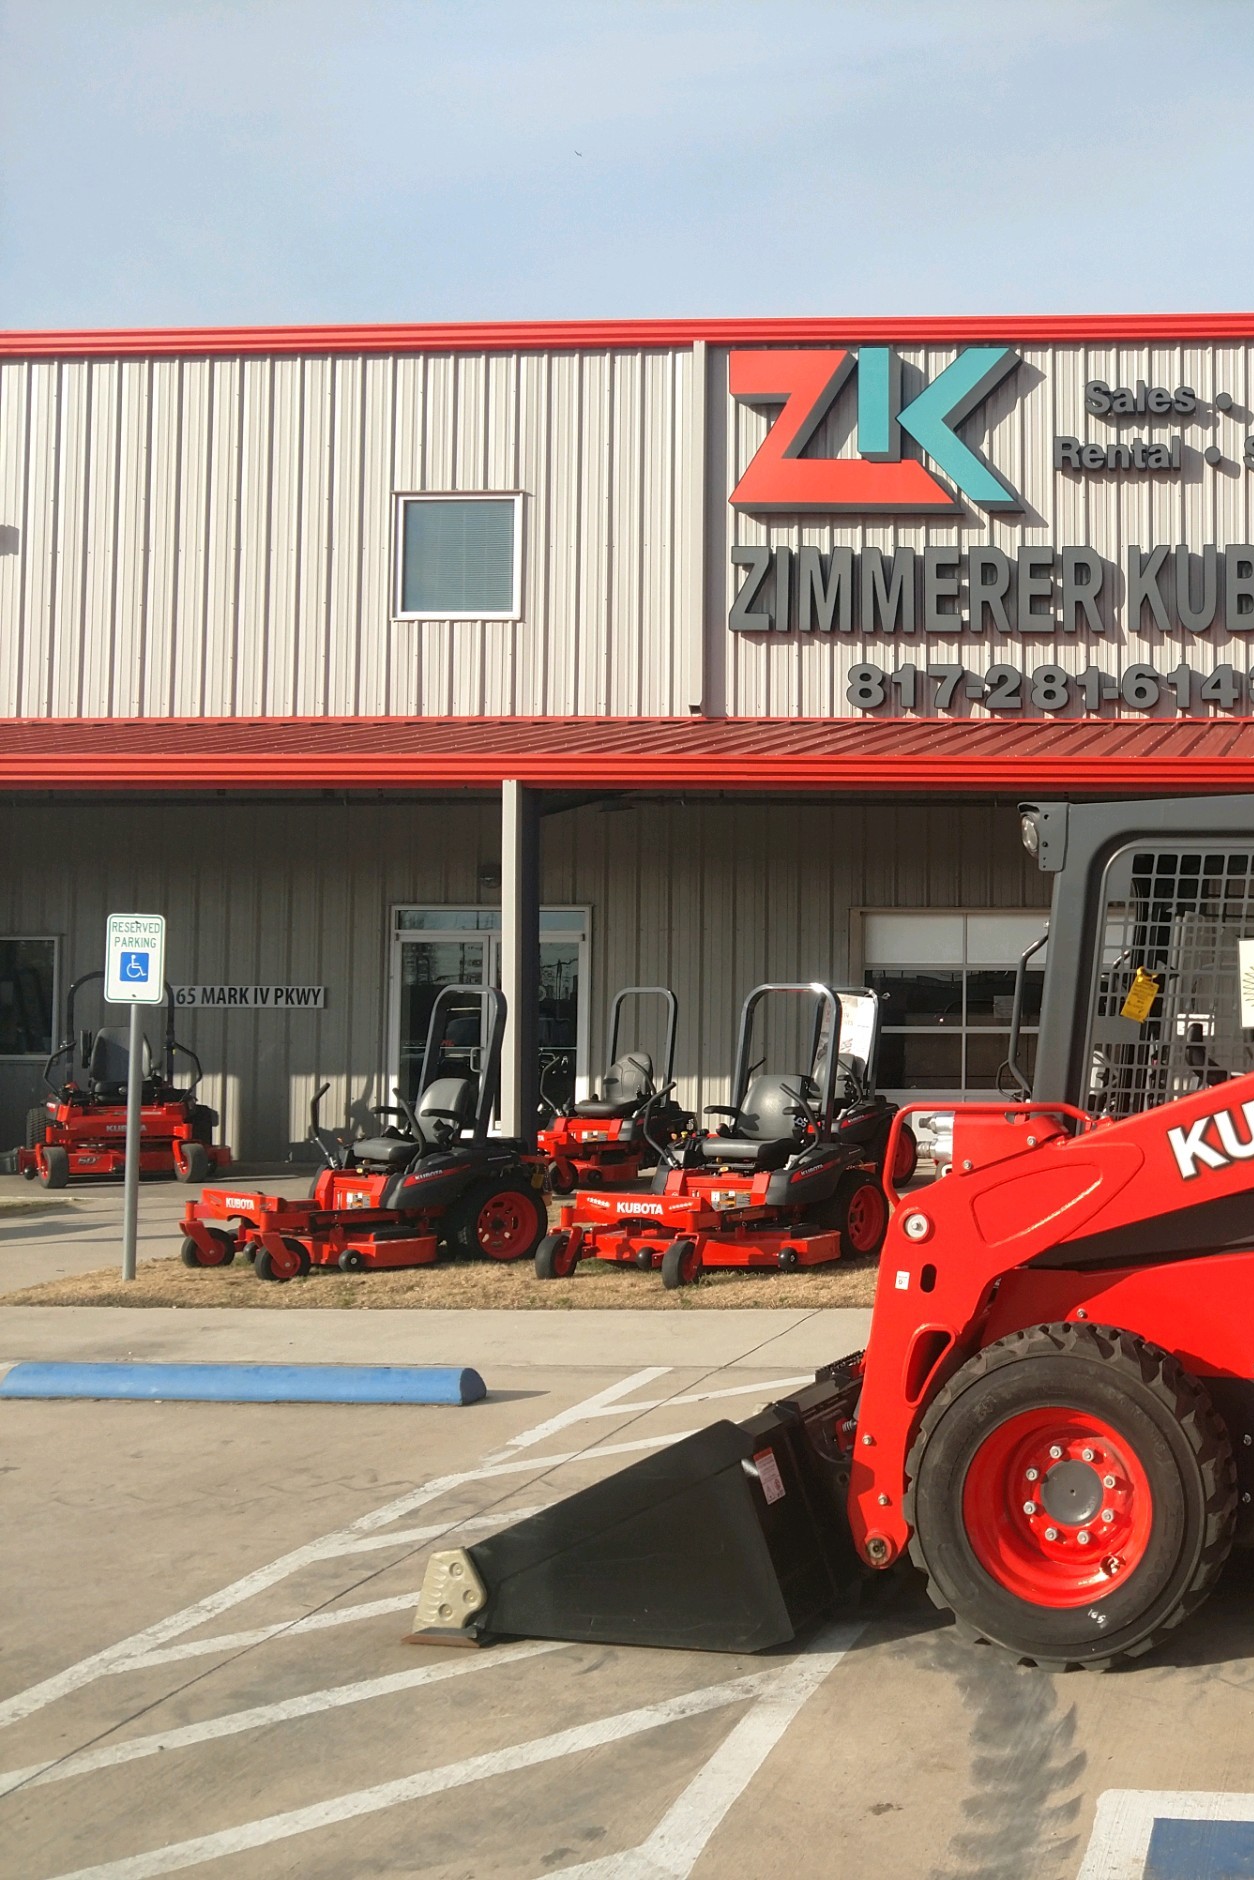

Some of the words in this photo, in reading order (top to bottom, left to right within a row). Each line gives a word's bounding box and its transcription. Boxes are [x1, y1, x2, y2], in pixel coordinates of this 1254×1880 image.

[1085, 379, 1196, 415] Sales
[728, 347, 1024, 513] ZK
[1053, 435, 1182, 471] Rental
[729, 545, 1105, 634] ZIMMERER
[111, 921, 161, 934] RESERVED
[114, 937, 157, 949] PARKING
[201, 987, 250, 1005] MARK
[253, 987, 270, 1005] IV
[274, 987, 321, 1006] PKWY
[106, 1124, 147, 1132] KUBA
[225, 1197, 255, 1210] KUBOTA
[616, 1202, 664, 1215] KUBOTA
